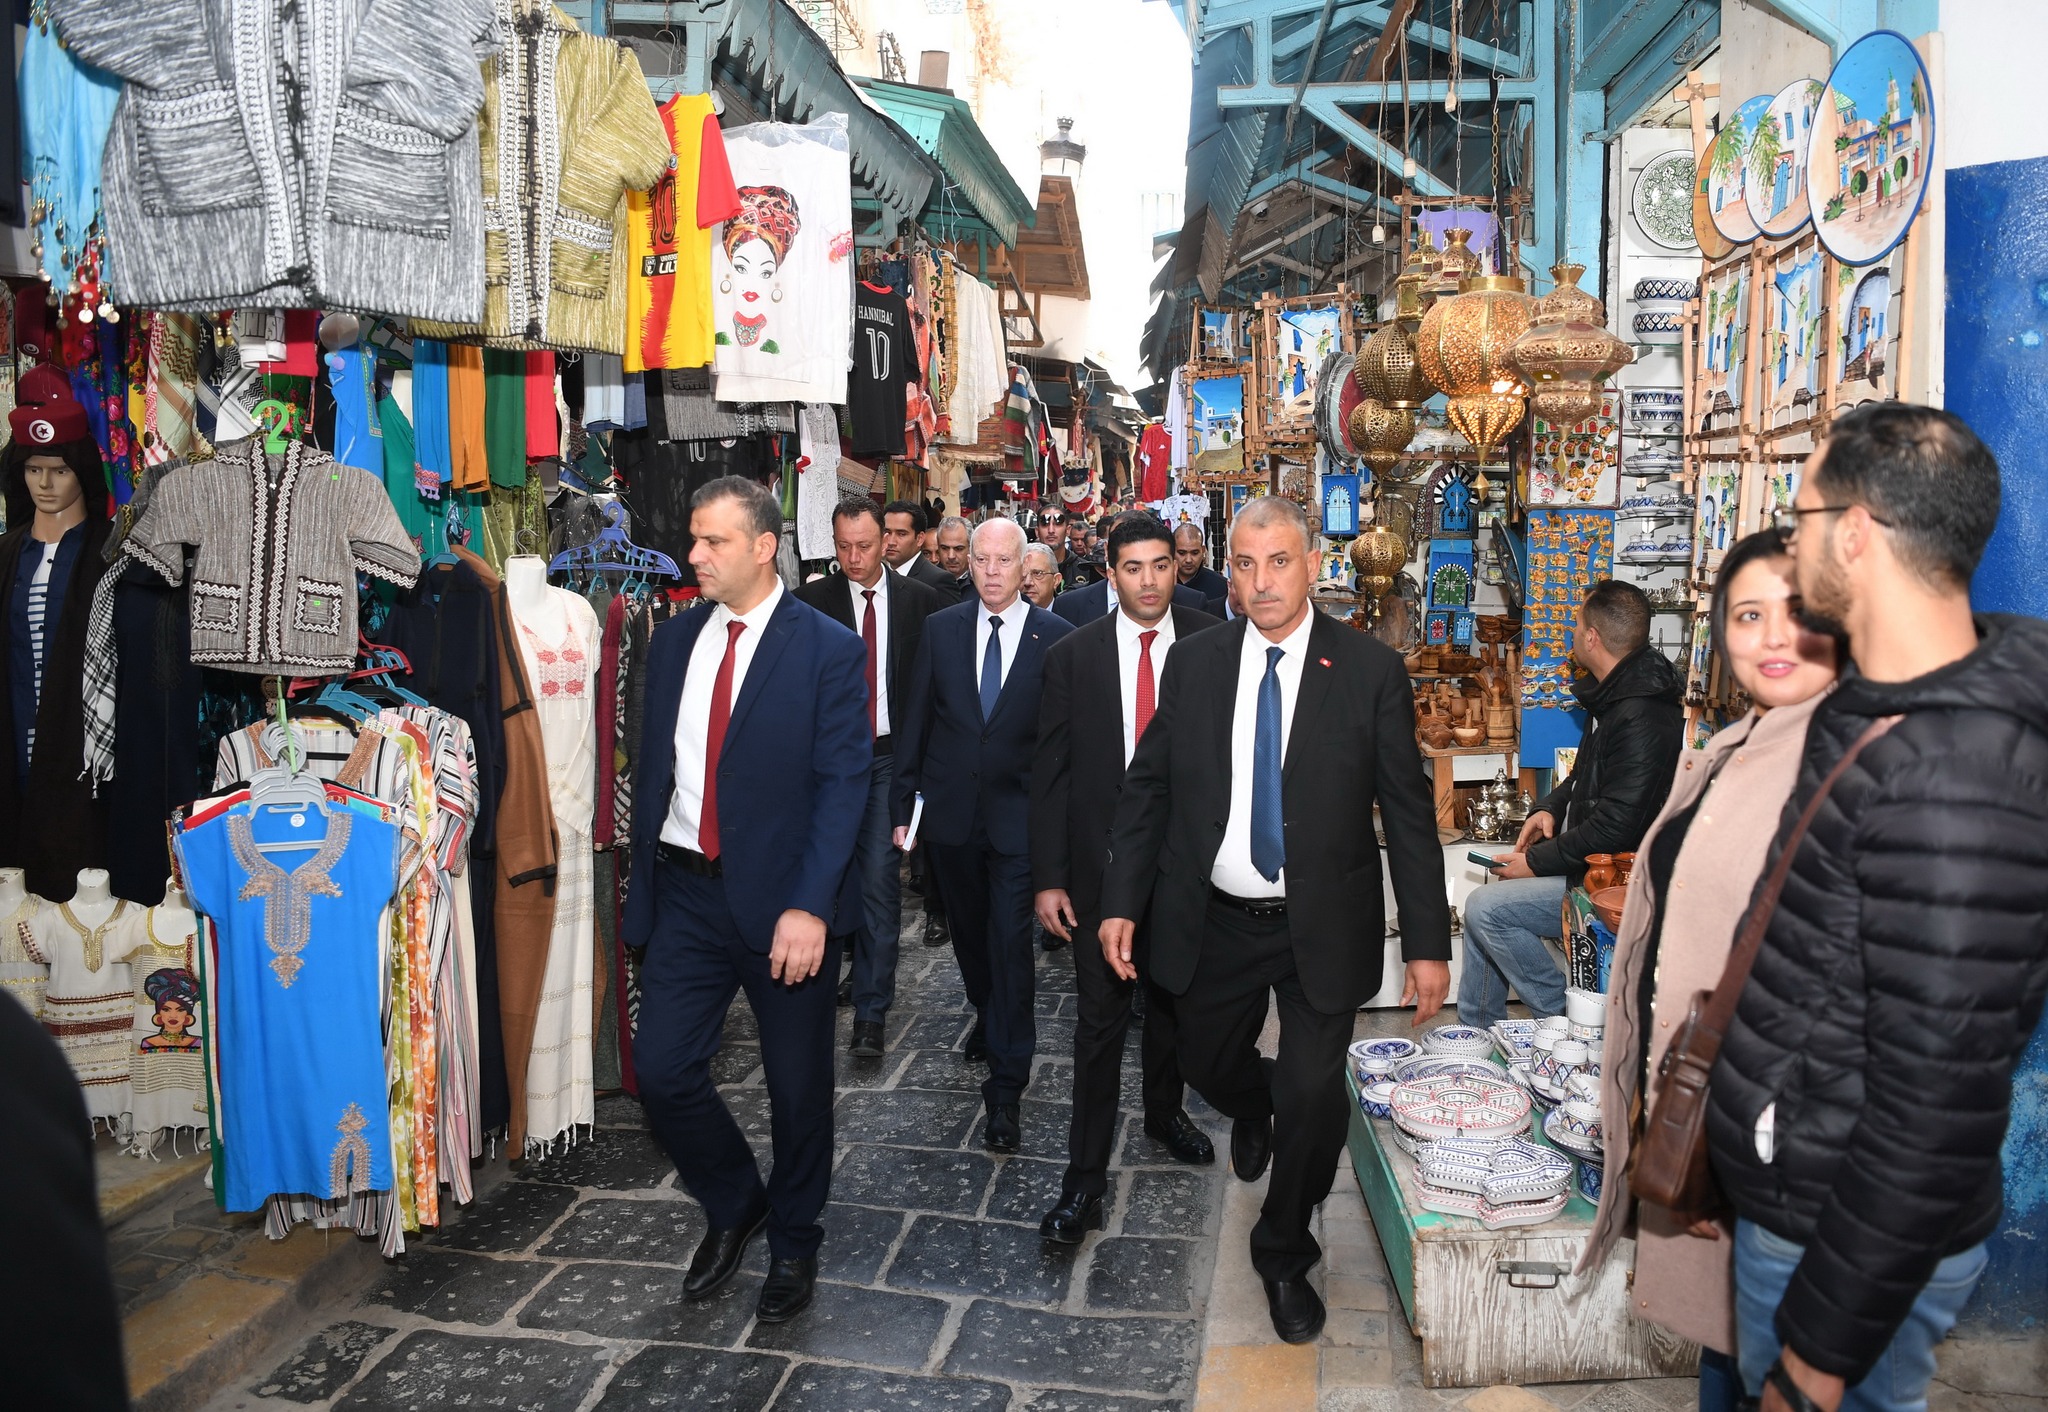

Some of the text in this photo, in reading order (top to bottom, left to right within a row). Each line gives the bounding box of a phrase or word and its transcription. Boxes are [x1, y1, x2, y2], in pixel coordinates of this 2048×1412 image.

[648, 175, 677, 247] 10
[858, 305, 894, 326] HANNIBAL
[865, 327, 890, 380] 10
